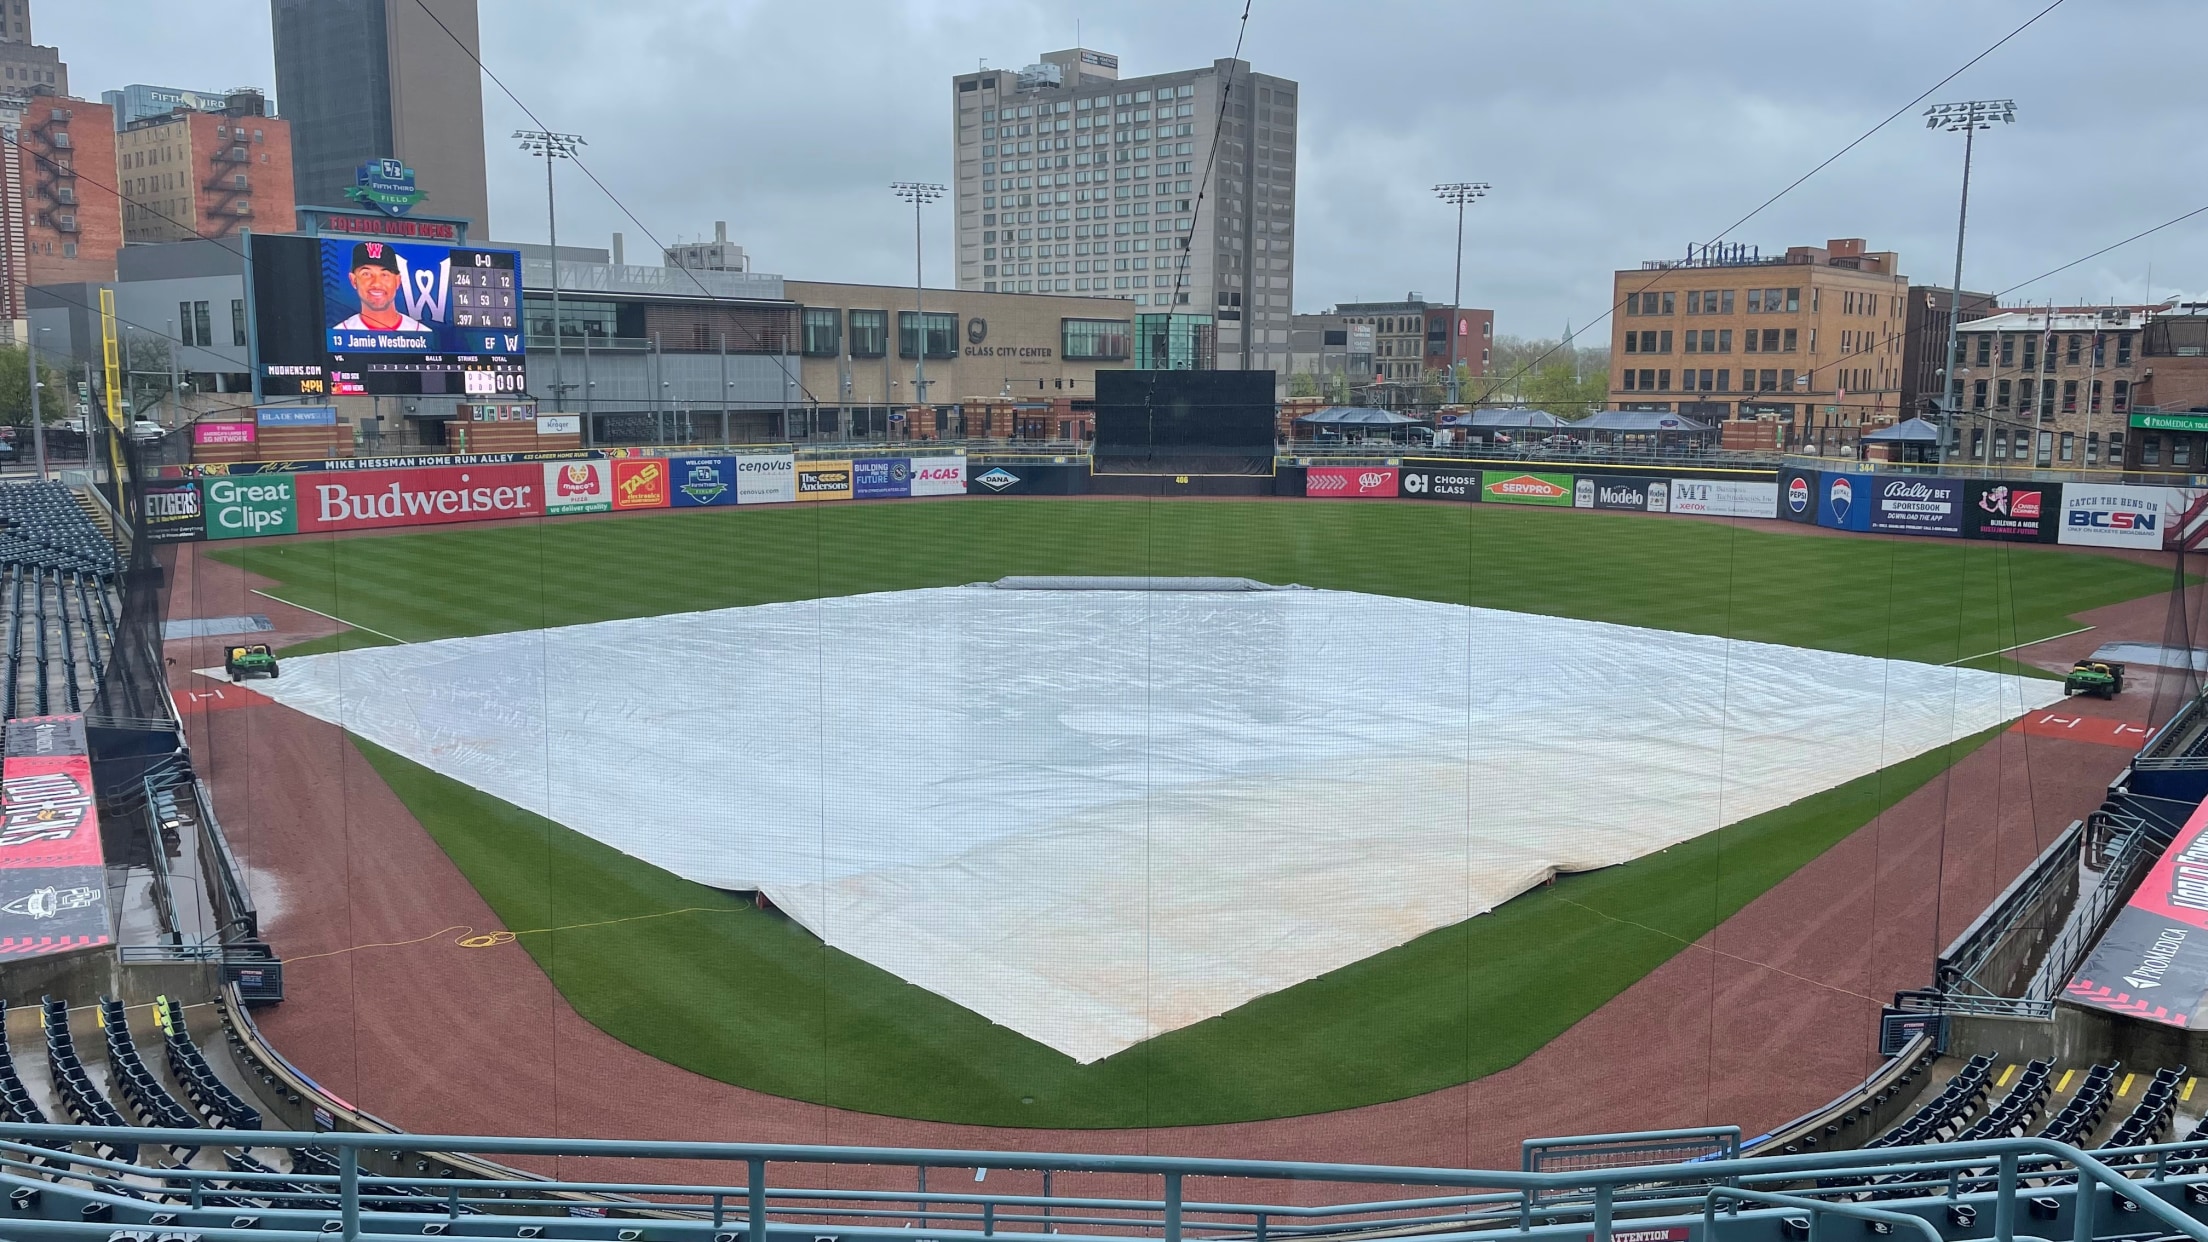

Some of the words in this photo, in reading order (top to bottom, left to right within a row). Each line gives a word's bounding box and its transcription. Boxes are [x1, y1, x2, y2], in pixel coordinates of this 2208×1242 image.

[151, 92, 183, 103] FIFTH
[372, 182, 392, 190] FIFTH
[393, 184, 415, 192] THIRD
[381, 195, 408, 203] FIELD
[330, 216, 381, 233] TOLEDO
[385, 221, 416, 236] MUD
[419, 224, 453, 239] HENS
[475, 254, 491, 267] 0-0
[455, 274, 471, 285] .264
[481, 275, 487, 286] 2
[501, 276, 510, 288] 12
[459, 294, 468, 305] 14
[480, 295, 490, 306] 53
[503, 296, 509, 306] 9
[457, 314, 472, 326] .397
[482, 315, 491, 326] 14
[503, 316, 512, 327] 12
[332, 335, 342, 346] 13
[348, 334, 377, 347] Jamie
[378, 336, 427, 349] Westbrook
[485, 338, 496, 349] EF
[965, 347, 994, 356] GLASS
[997, 347, 1017, 357] CITY
[1019, 347, 1051, 357] CENTER
[268, 366, 321, 376] MUDHENS.COM
[301, 380, 323, 393] MPH
[547, 418, 568, 432] Kroger
[2152, 418, 2193, 429] PROMEDICA
[325, 460, 355, 470] MIKE
[359, 458, 415, 468] HESSMAN
[419, 456, 450, 466] HOME
[455, 455, 477, 464] RUN
[480, 454, 514, 463] ALLEY
[738, 460, 792, 472] cenovus
[855, 464, 888, 472] BUILDING
[1859, 463, 1874, 472] 344
[620, 464, 660, 494] TAS
[800, 473, 817, 482] The
[857, 476, 888, 484] FUTURE
[920, 469, 959, 480] A-GAS
[1361, 474, 1380, 487] AAA
[1434, 476, 1475, 485] CHOOSE
[210, 480, 290, 503] Great
[801, 482, 848, 491] Andersons
[1434, 486, 1465, 494] GLASS
[1676, 484, 1712, 500] MT
[1884, 481, 1933, 502] Bally
[1935, 489, 1951, 499] BET
[316, 474, 531, 522] Budweiser
[1600, 487, 1643, 504] Modelo
[1790, 490, 1807, 500] PEPSI
[144, 492, 198, 516] ETZGERS
[561, 504, 584, 512] deliver
[584, 503, 608, 512] quality
[1680, 503, 1705, 511] xerox
[1893, 502, 1940, 511] SPORTSBOOK
[2070, 497, 2097, 507] CATCH
[2101, 497, 2118, 505] THE
[2121, 498, 2143, 508] HENS
[2146, 502, 2158, 512] ON
[219, 507, 283, 532] Clips
[2068, 510, 2156, 530] BCSN
[2132, 928, 2189, 980] PROMEDICA
[1611, 1230, 1669, 1242] ATTENTION
